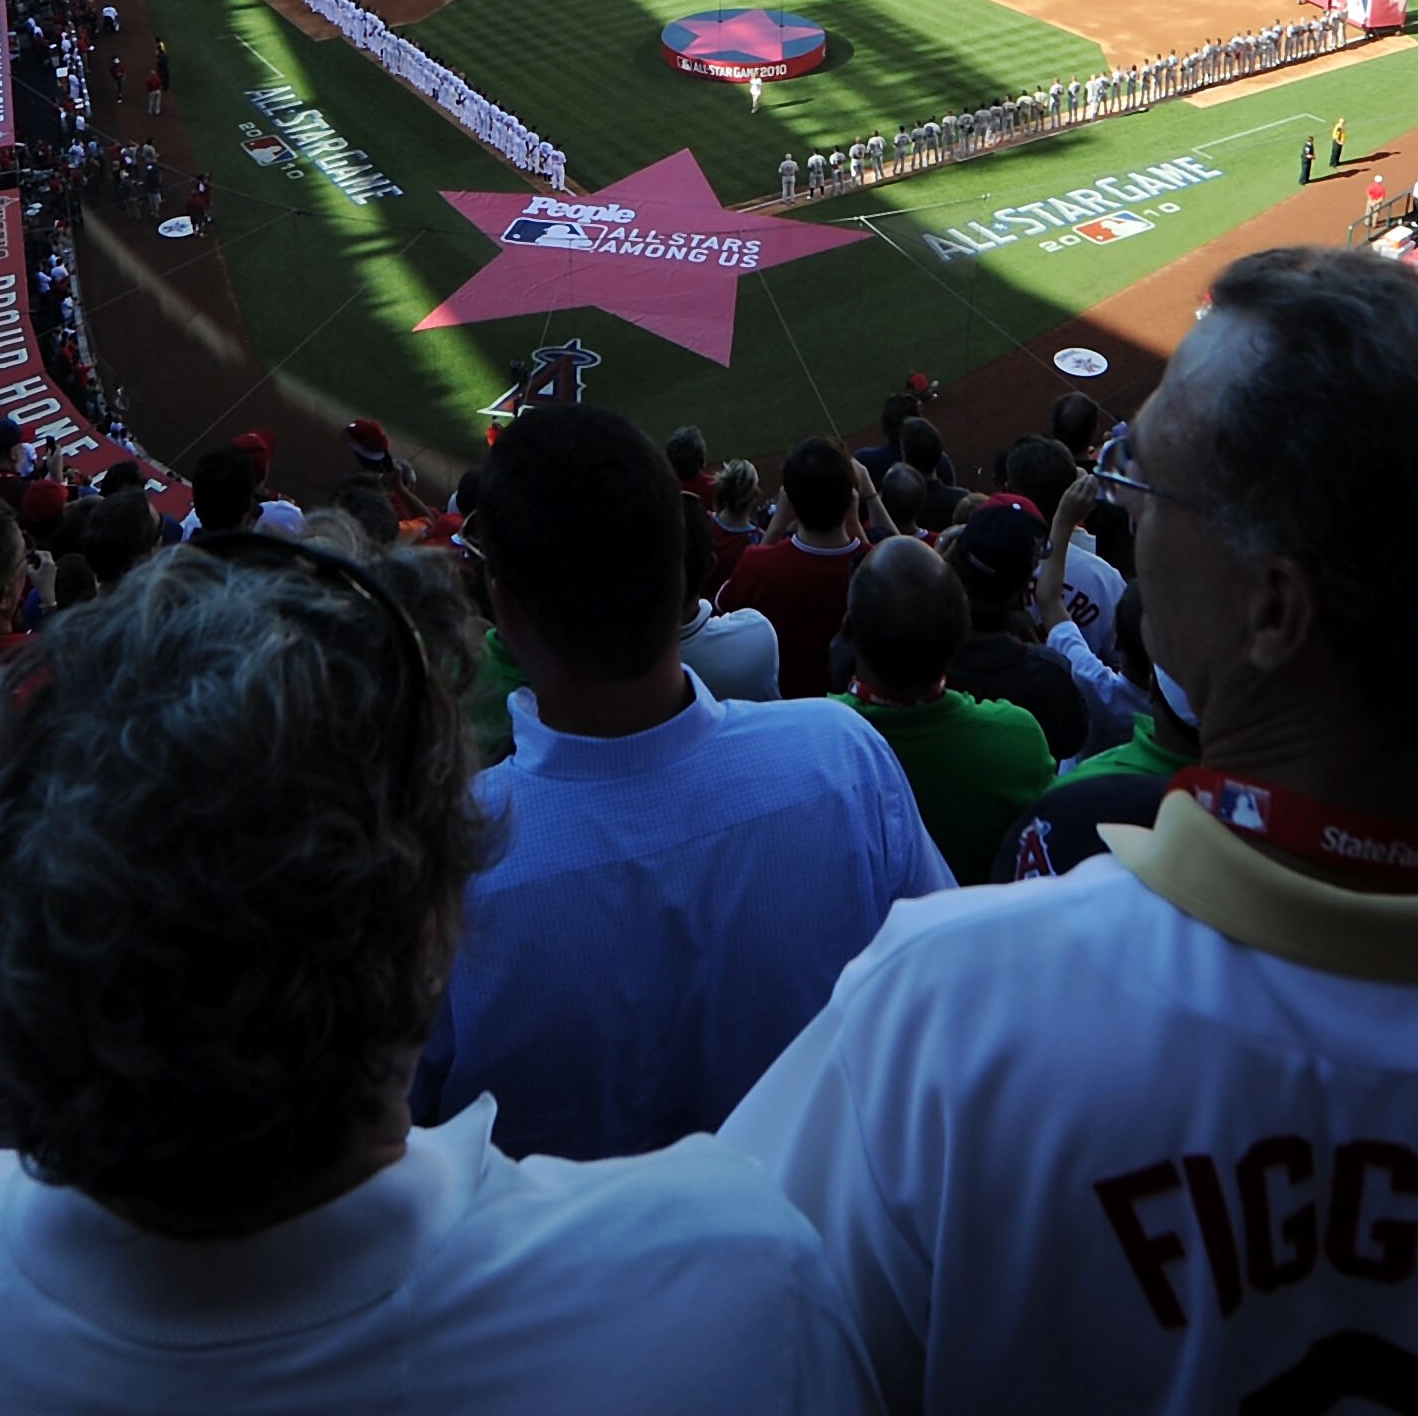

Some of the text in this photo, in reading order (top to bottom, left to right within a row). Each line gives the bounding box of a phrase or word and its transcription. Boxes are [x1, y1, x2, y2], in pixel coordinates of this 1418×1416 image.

[734, 66, 760, 79] GAME
[760, 64, 787, 78] 2010
[238, 121, 263, 138] 20
[281, 162, 304, 180] 10
[315, 149, 404, 206] GAME
[1095, 156, 1223, 203] GAME
[522, 196, 636, 225] People
[1143, 202, 1181, 217] 10
[599, 240, 760, 269] AMONG US
[607, 226, 762, 255] ALL-STARS
[1039, 234, 1082, 253] 20
[1319, 824, 1385, 863] State
